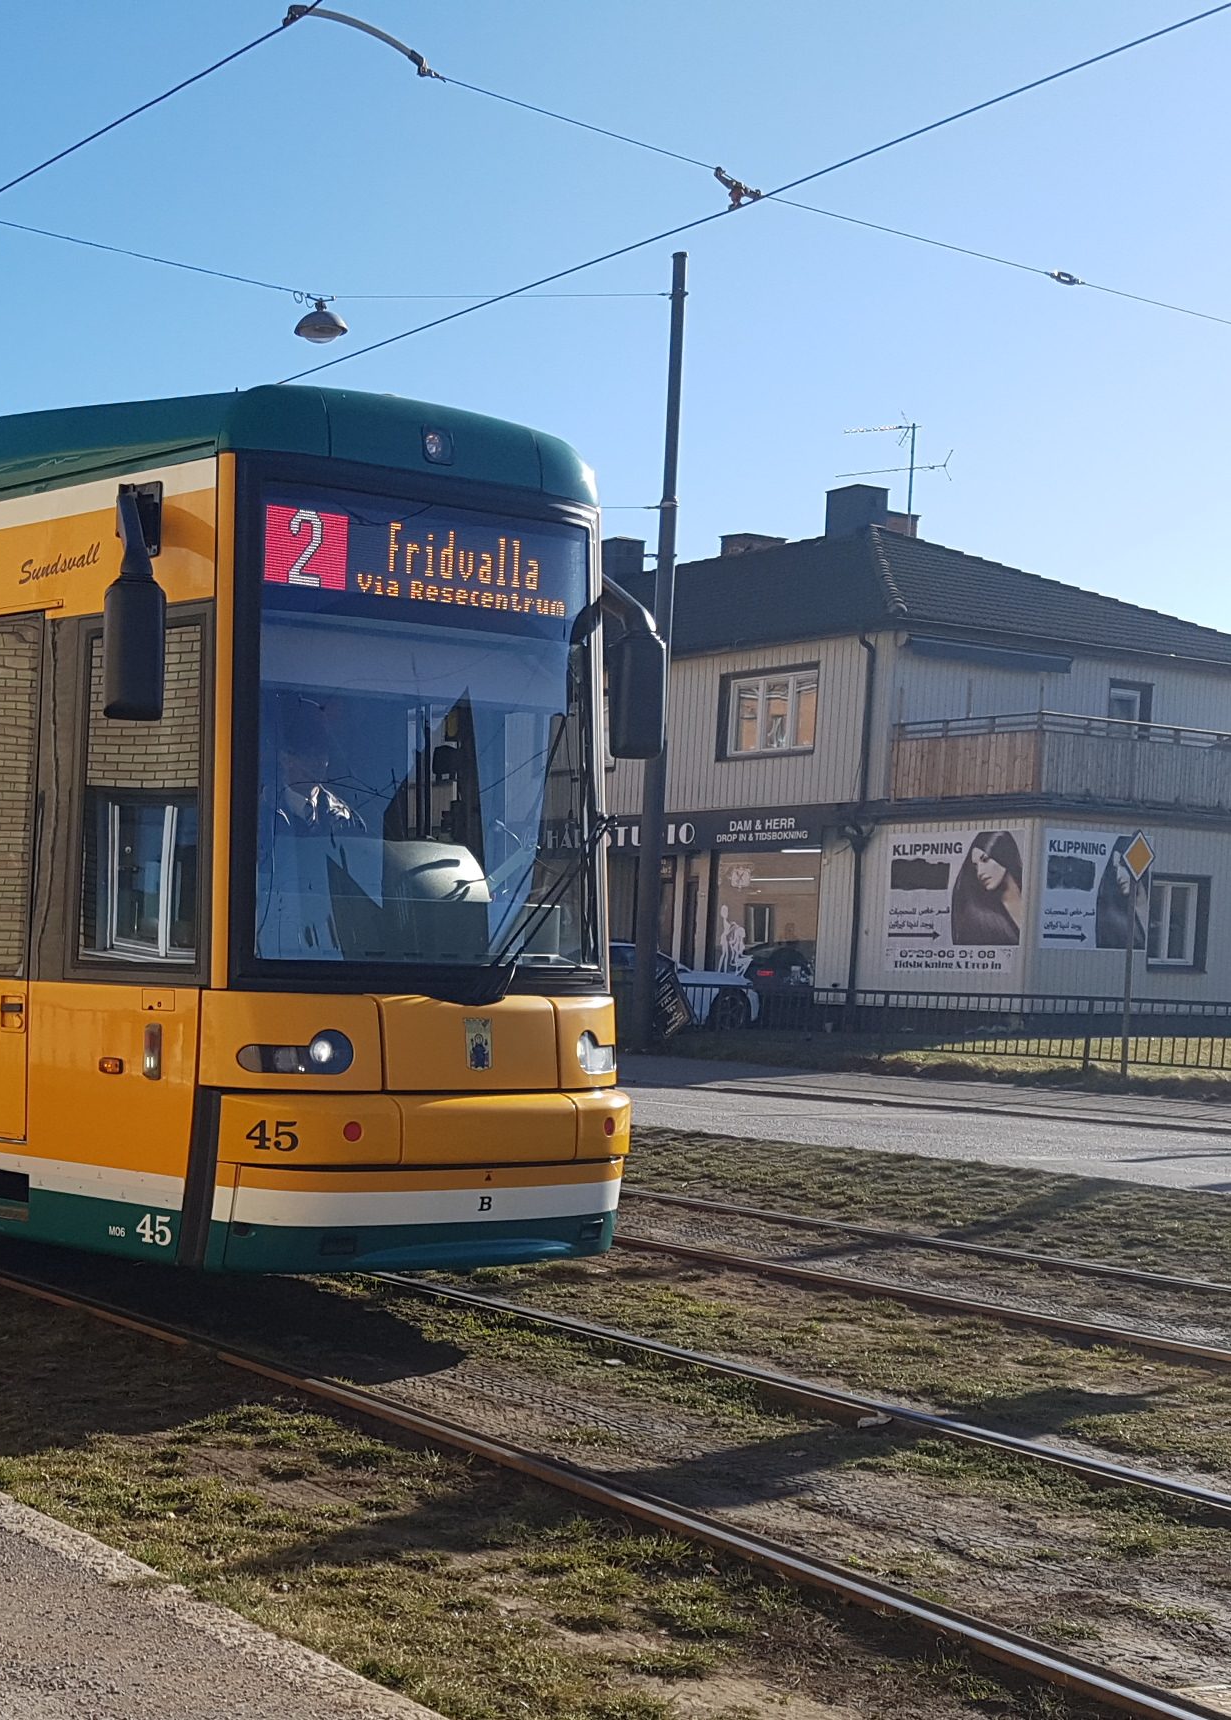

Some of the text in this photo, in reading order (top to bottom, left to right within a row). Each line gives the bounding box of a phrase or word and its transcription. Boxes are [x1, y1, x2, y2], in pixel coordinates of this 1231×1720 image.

[18, 541, 101, 585] Sundsvall
[288, 508, 323, 588] 2
[386, 521, 540, 591] Fridvalla
[410, 580, 565, 617] Resecentrum
[716, 830, 809, 843] DROP IN & TIDSBOKNING
[729, 817, 796, 832] DAM & HERR
[892, 841, 963, 856] KLIPPNING
[1049, 839, 1107, 856] KLIPPNING
[245, 1119, 299, 1152] 45
[477, 1196, 493, 1212] B
[108, 1213, 172, 1246] M06 45
